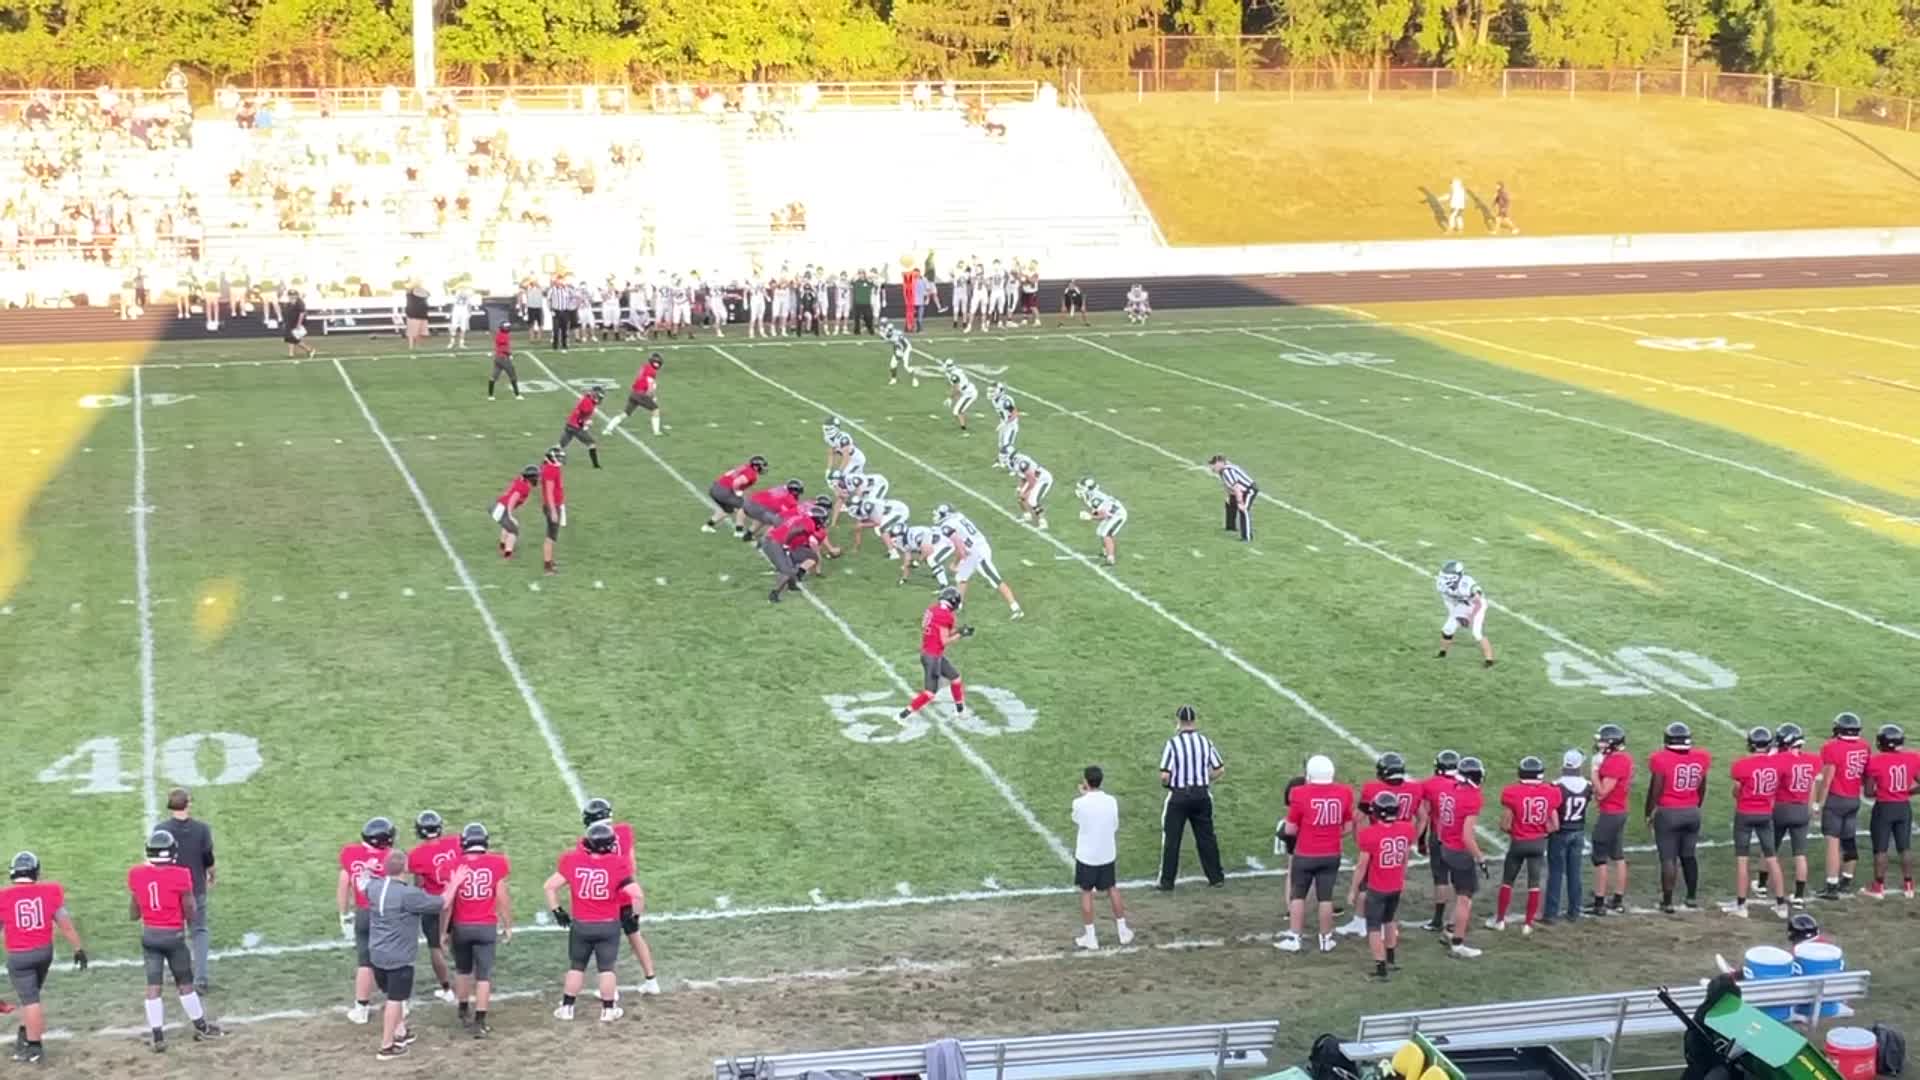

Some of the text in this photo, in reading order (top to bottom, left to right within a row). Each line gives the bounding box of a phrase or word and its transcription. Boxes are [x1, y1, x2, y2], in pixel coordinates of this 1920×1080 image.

[1543, 646, 1739, 696] 40
[821, 684, 1049, 743] 50
[36, 732, 263, 793] 40
[1673, 763, 1703, 792] 66
[1752, 768, 1778, 796] 12
[1789, 764, 1814, 792] 15
[1889, 765, 1908, 793] 11
[1310, 798, 1342, 826] 70
[1522, 796, 1549, 825] 13
[1564, 796, 1586, 821] 12
[148, 881, 161, 911] 1
[460, 868, 493, 899] 32
[576, 867, 609, 900] 72
[15, 897, 45, 931] 61
